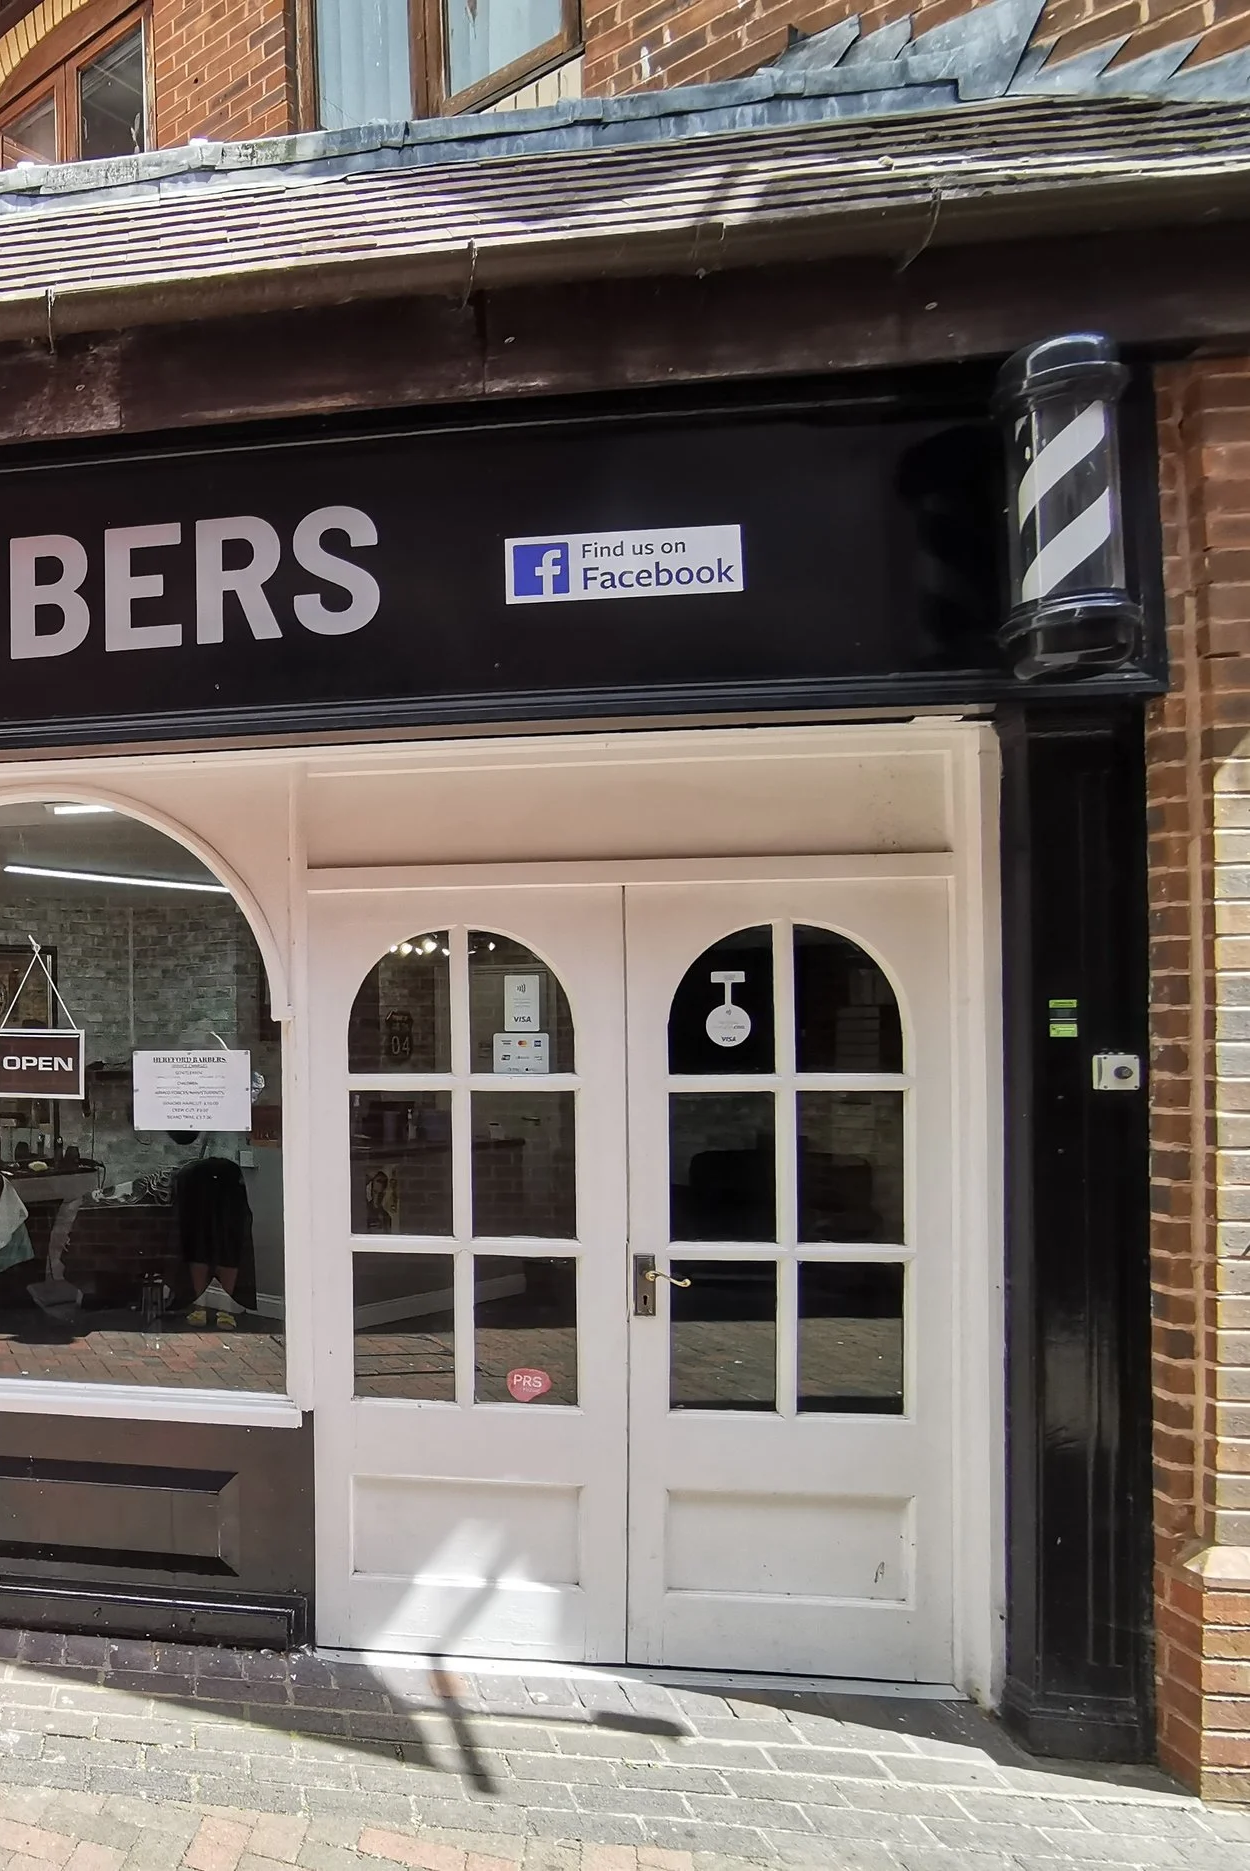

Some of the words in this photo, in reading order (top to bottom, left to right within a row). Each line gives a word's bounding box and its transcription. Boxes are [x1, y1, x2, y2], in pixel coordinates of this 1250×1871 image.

[582, 541, 624, 559] Find
[632, 541, 654, 556] us
[661, 540, 687, 554] on
[582, 557, 735, 591] Facebook
[2, 1055, 74, 1072] OPEN
[153, 1056, 192, 1064] HEREFORD
[192, 1056, 228, 1064] BARBERS
[513, 1374, 542, 1388] PRS
